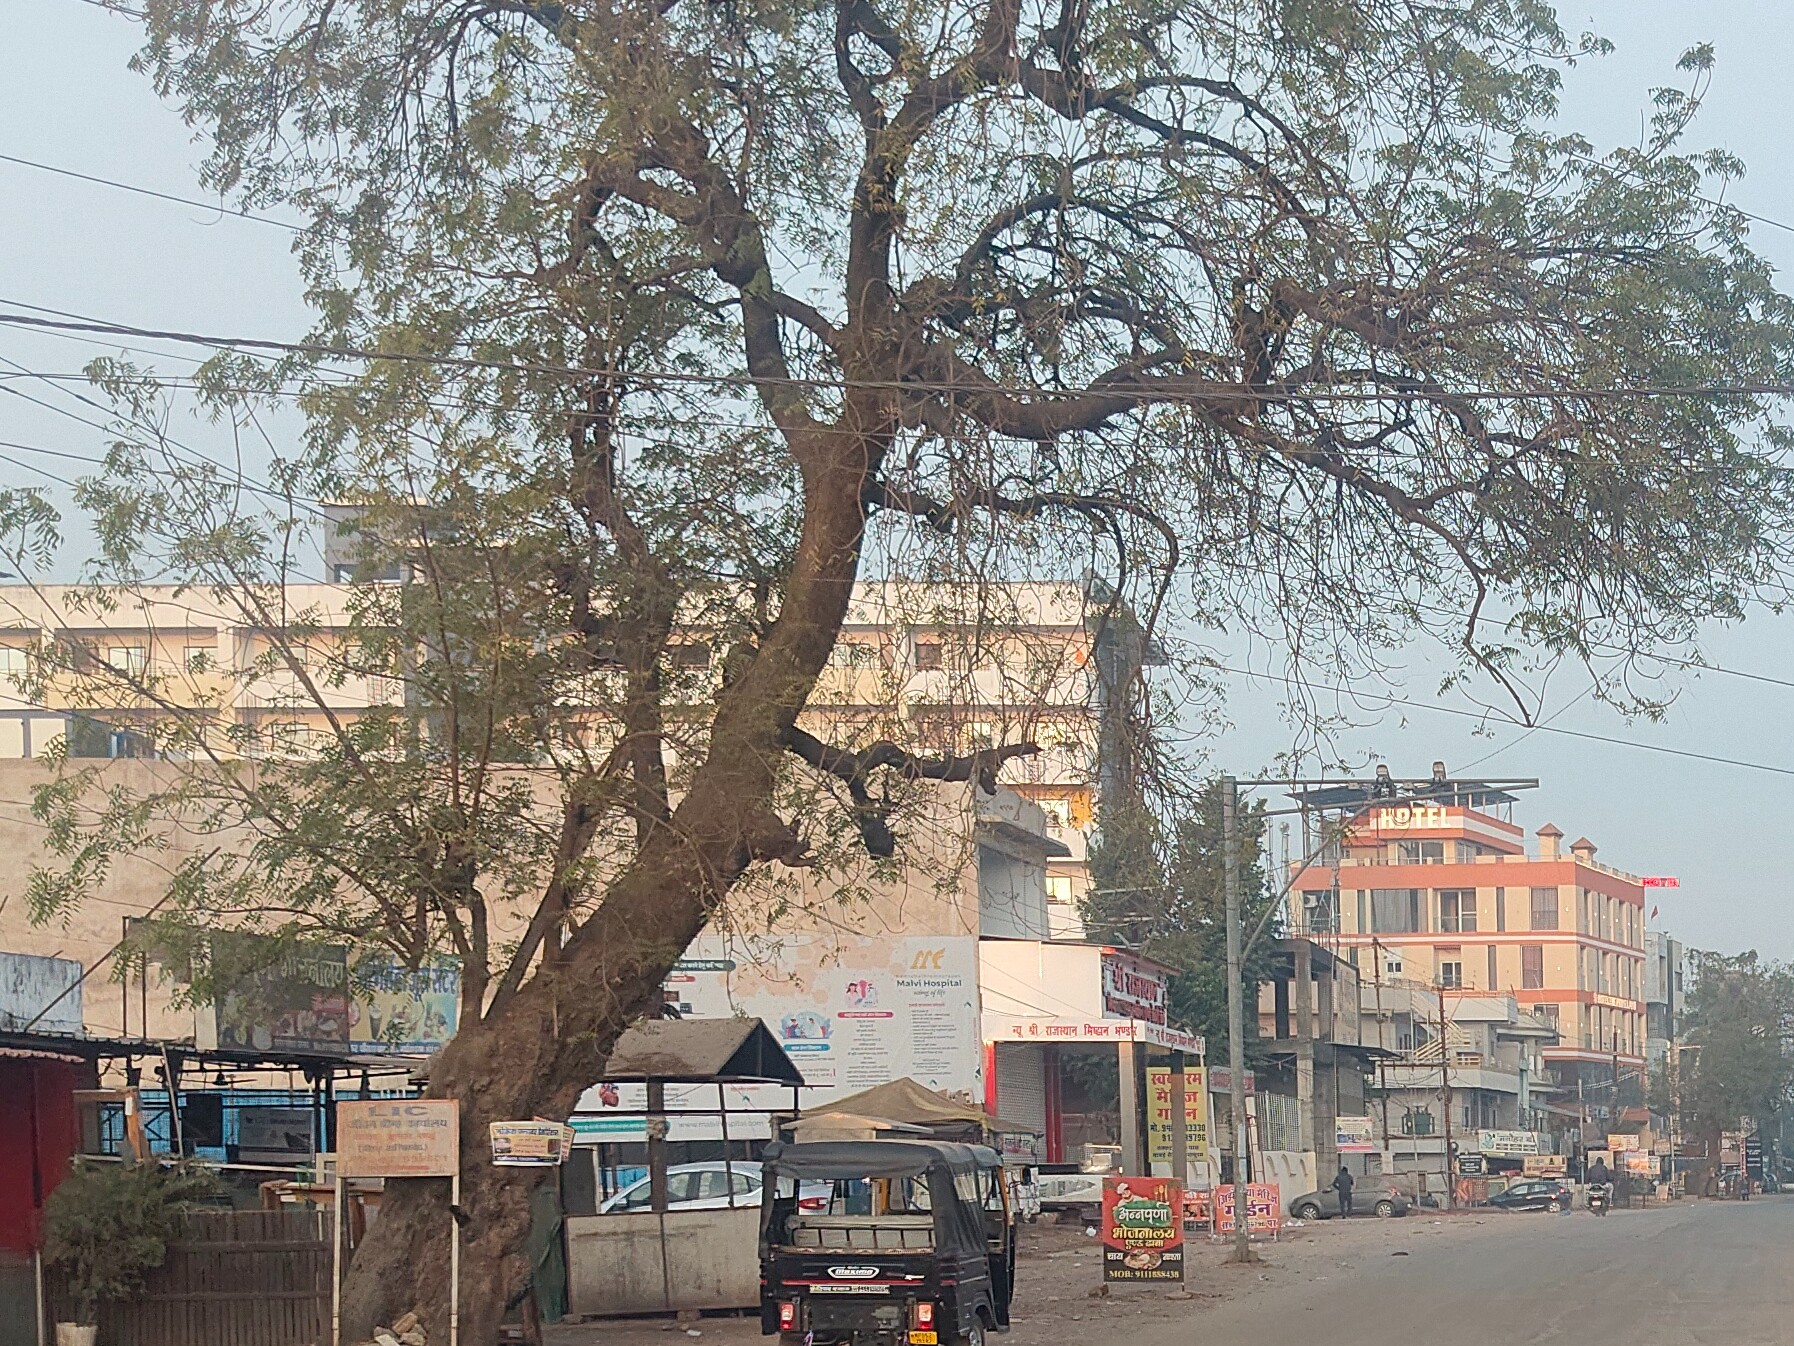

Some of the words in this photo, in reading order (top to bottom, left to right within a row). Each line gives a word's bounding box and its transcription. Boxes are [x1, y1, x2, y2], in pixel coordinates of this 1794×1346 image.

[1380, 806, 1452, 831] HOTEL
[897, 979, 922, 988] Malvi
[924, 979, 962, 988] Hospital
[1013, 1025, 1024, 1038] न्यू
[1029, 1023, 1038, 1036] श्री
[1046, 1025, 1077, 1036] राजस्थान
[368, 1106, 428, 1117] LIC
[1112, 1227, 1175, 1239] भोजनालय
[1107, 1252, 1124, 1260] चाय
[1109, 1270, 1133, 1278] MOB:
